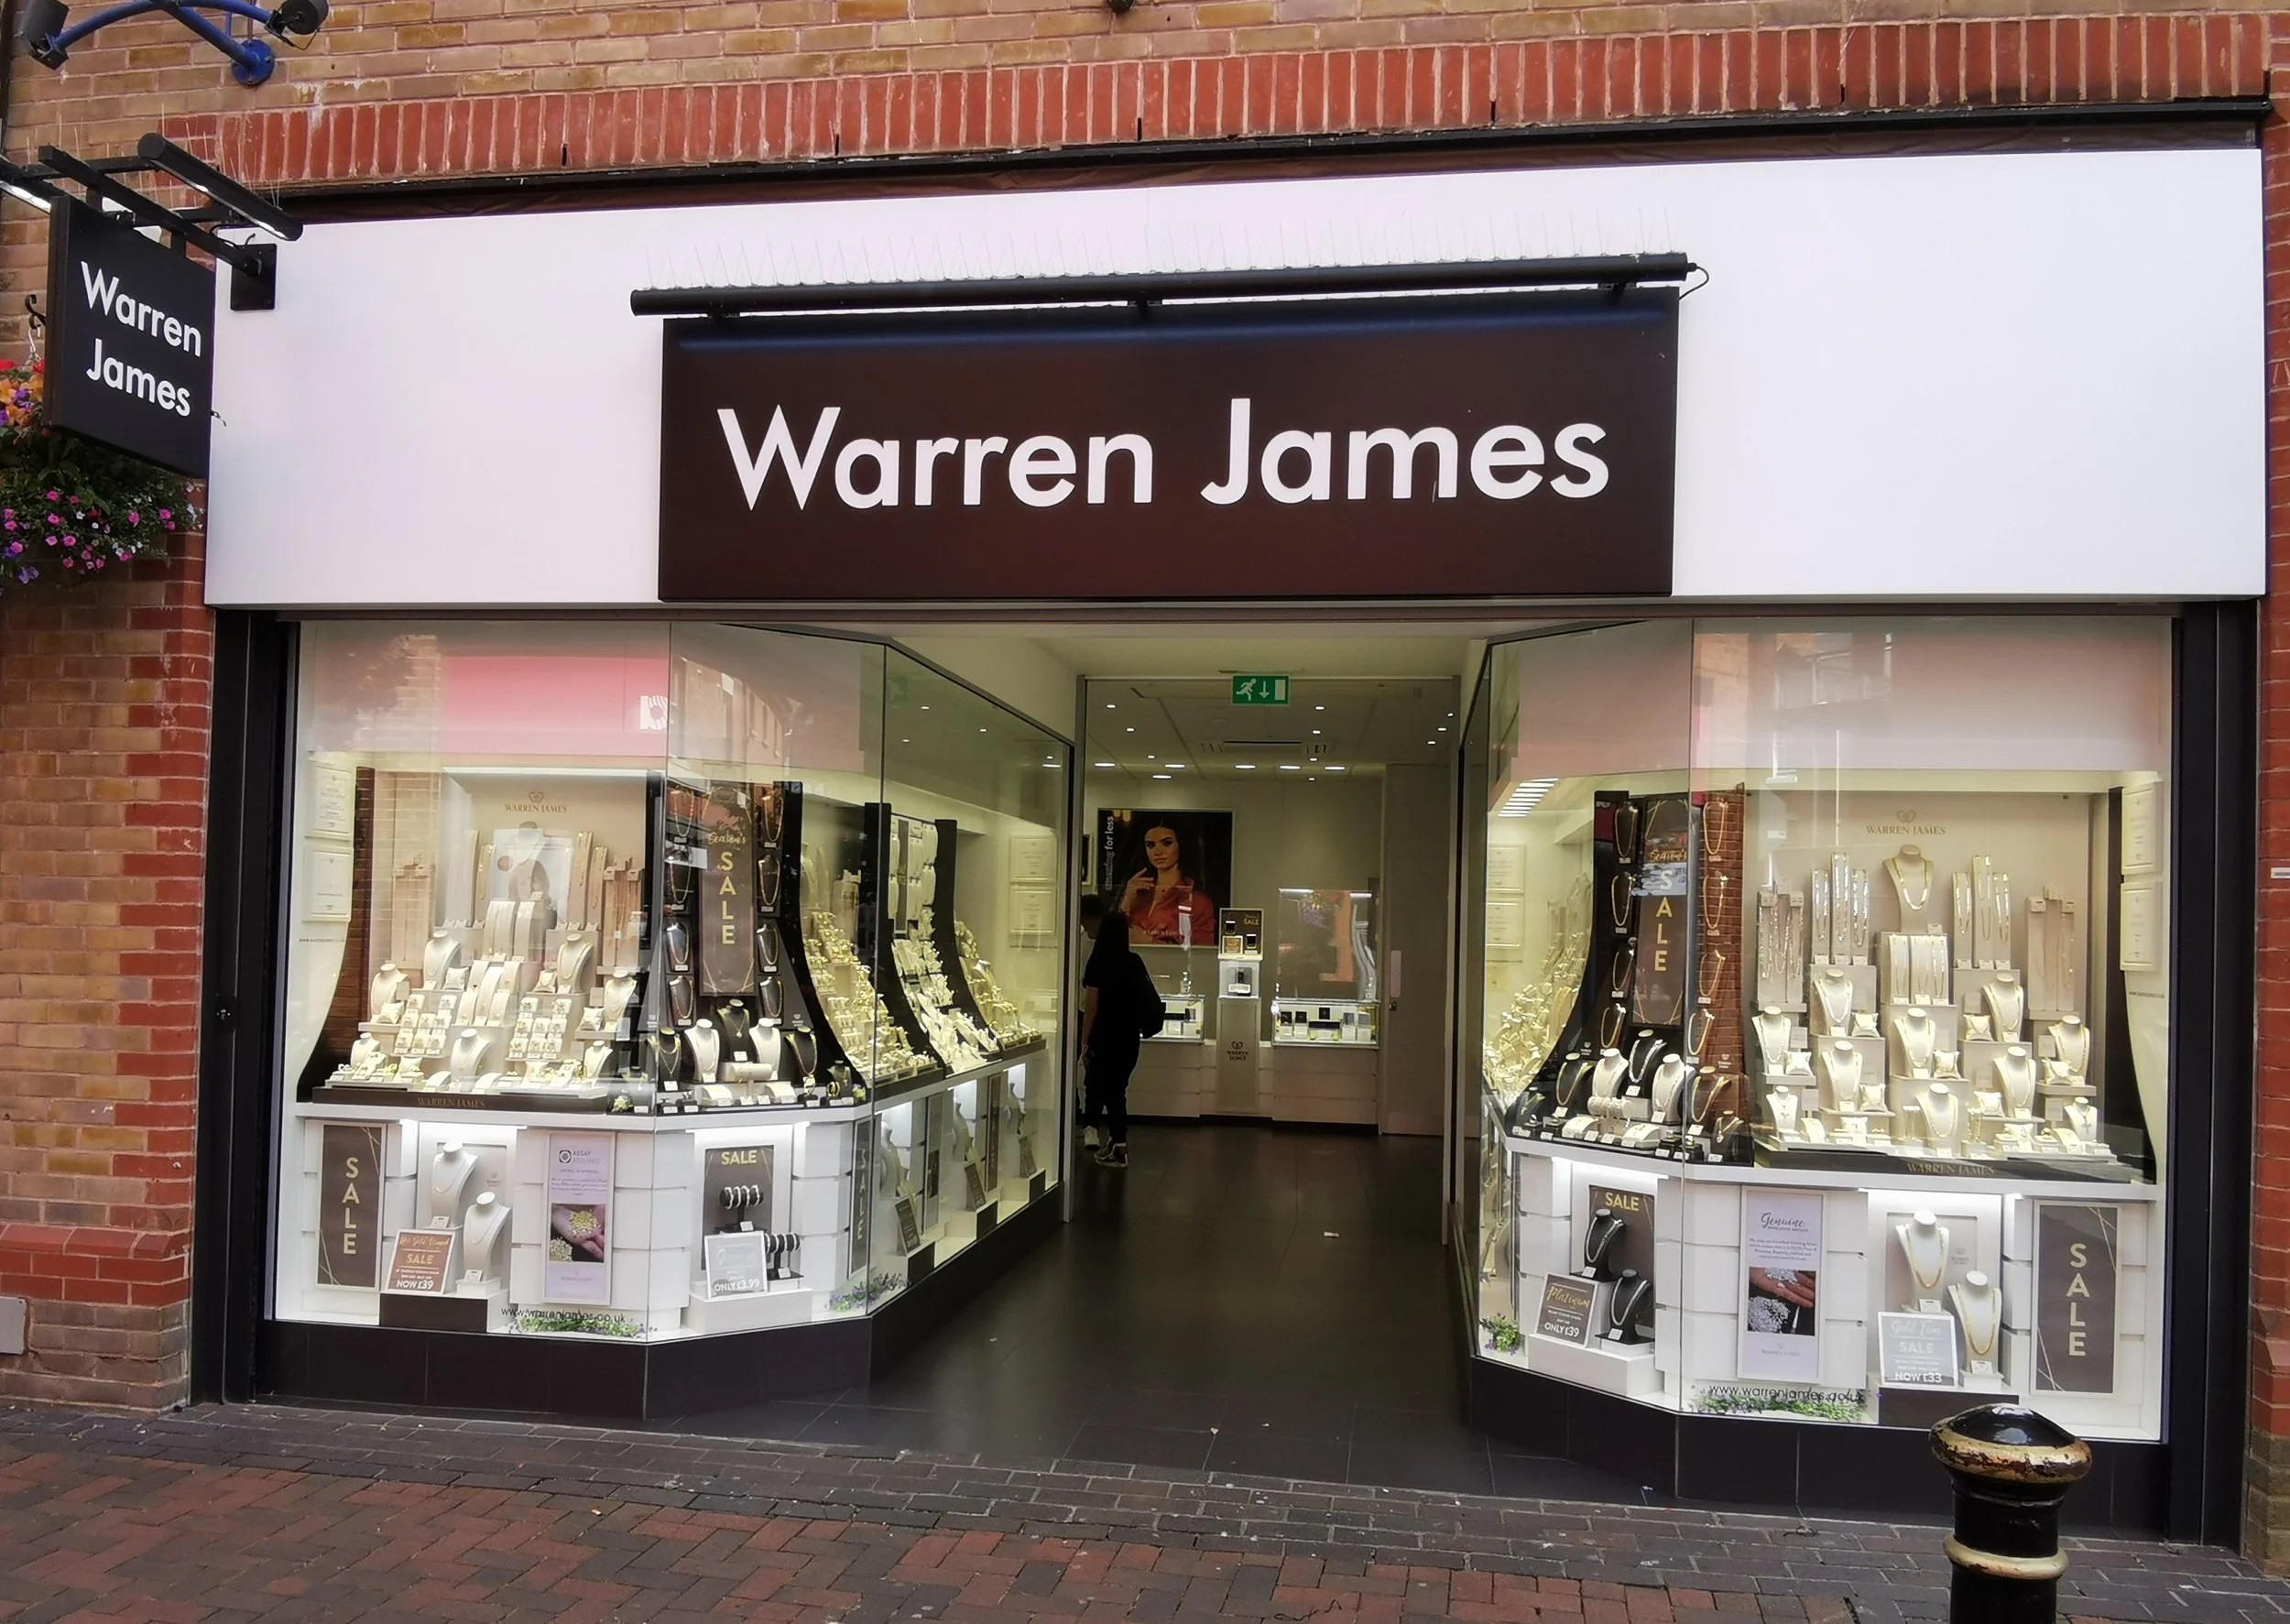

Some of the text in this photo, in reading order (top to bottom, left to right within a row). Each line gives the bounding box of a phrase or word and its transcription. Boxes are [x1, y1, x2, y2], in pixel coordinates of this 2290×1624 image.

[81, 260, 202, 357] Warren
[86, 337, 191, 417] James
[717, 398, 1609, 511] Warren James
[505, 803, 568, 813] WARREN JAMES
[1104, 815, 1114, 834] less
[1866, 825, 1946, 835] WARREN JAMES
[718, 851, 737, 945] SALE
[1653, 869, 1674, 972] SALE
[418, 1096, 485, 1107] WARREN JAMES
[721, 1150, 758, 1165] SALE
[1907, 1162, 1994, 1175] WARREN JAMES
[342, 1157, 360, 1255] SALE
[1605, 1192, 1641, 1212] SALE
[1760, 1211, 1805, 1229] Genuine
[406, 1253, 435, 1265] SALE
[396, 1279, 434, 1290] NOW £39
[714, 1281, 736, 1292] ONLY
[2066, 1243, 2090, 1357] SALE
[1544, 1322, 1580, 1337] ONLY £39
[1899, 1340, 1935, 1354] SALE
[1894, 1371, 1943, 1383] NOW £33
